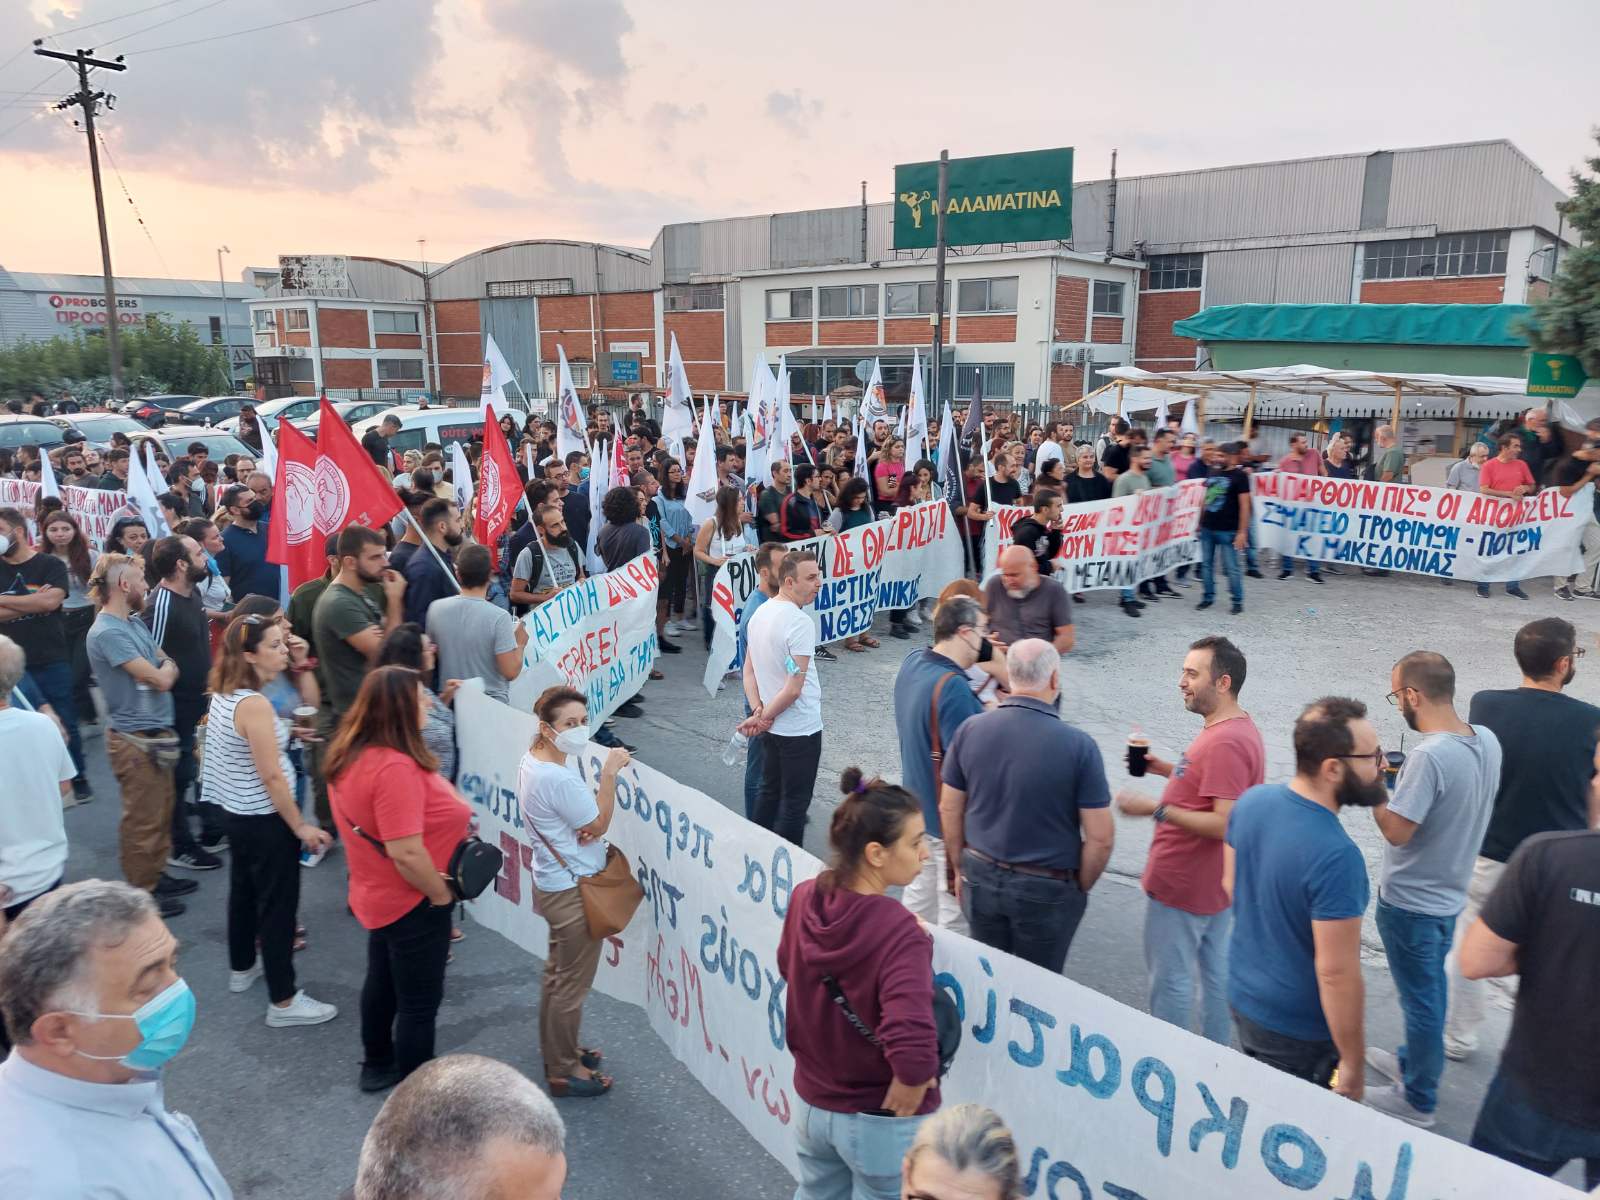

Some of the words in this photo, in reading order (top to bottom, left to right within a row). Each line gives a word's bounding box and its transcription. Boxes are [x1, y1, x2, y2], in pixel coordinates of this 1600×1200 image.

[56, 310, 142, 324] ΠΡΟΟΟΣ
[65, 296, 138, 309] PROBOERS
[1283, 473, 1376, 511] ΠΑΡΘΟΥΝ
[1381, 486, 1432, 518] ΠΙΣΩ
[1436, 493, 1462, 519] ΟΙ
[1359, 514, 1461, 550] ΤΡΟΦΙΜΩΝ
[1477, 526, 1542, 556] ΠΟΤΩΝ
[627, 556, 658, 592] ΘΑ
[832, 534, 855, 578] ΔΕ
[1320, 537, 1458, 577] ΜΑΚΕΔΟΝΙΑΣ
